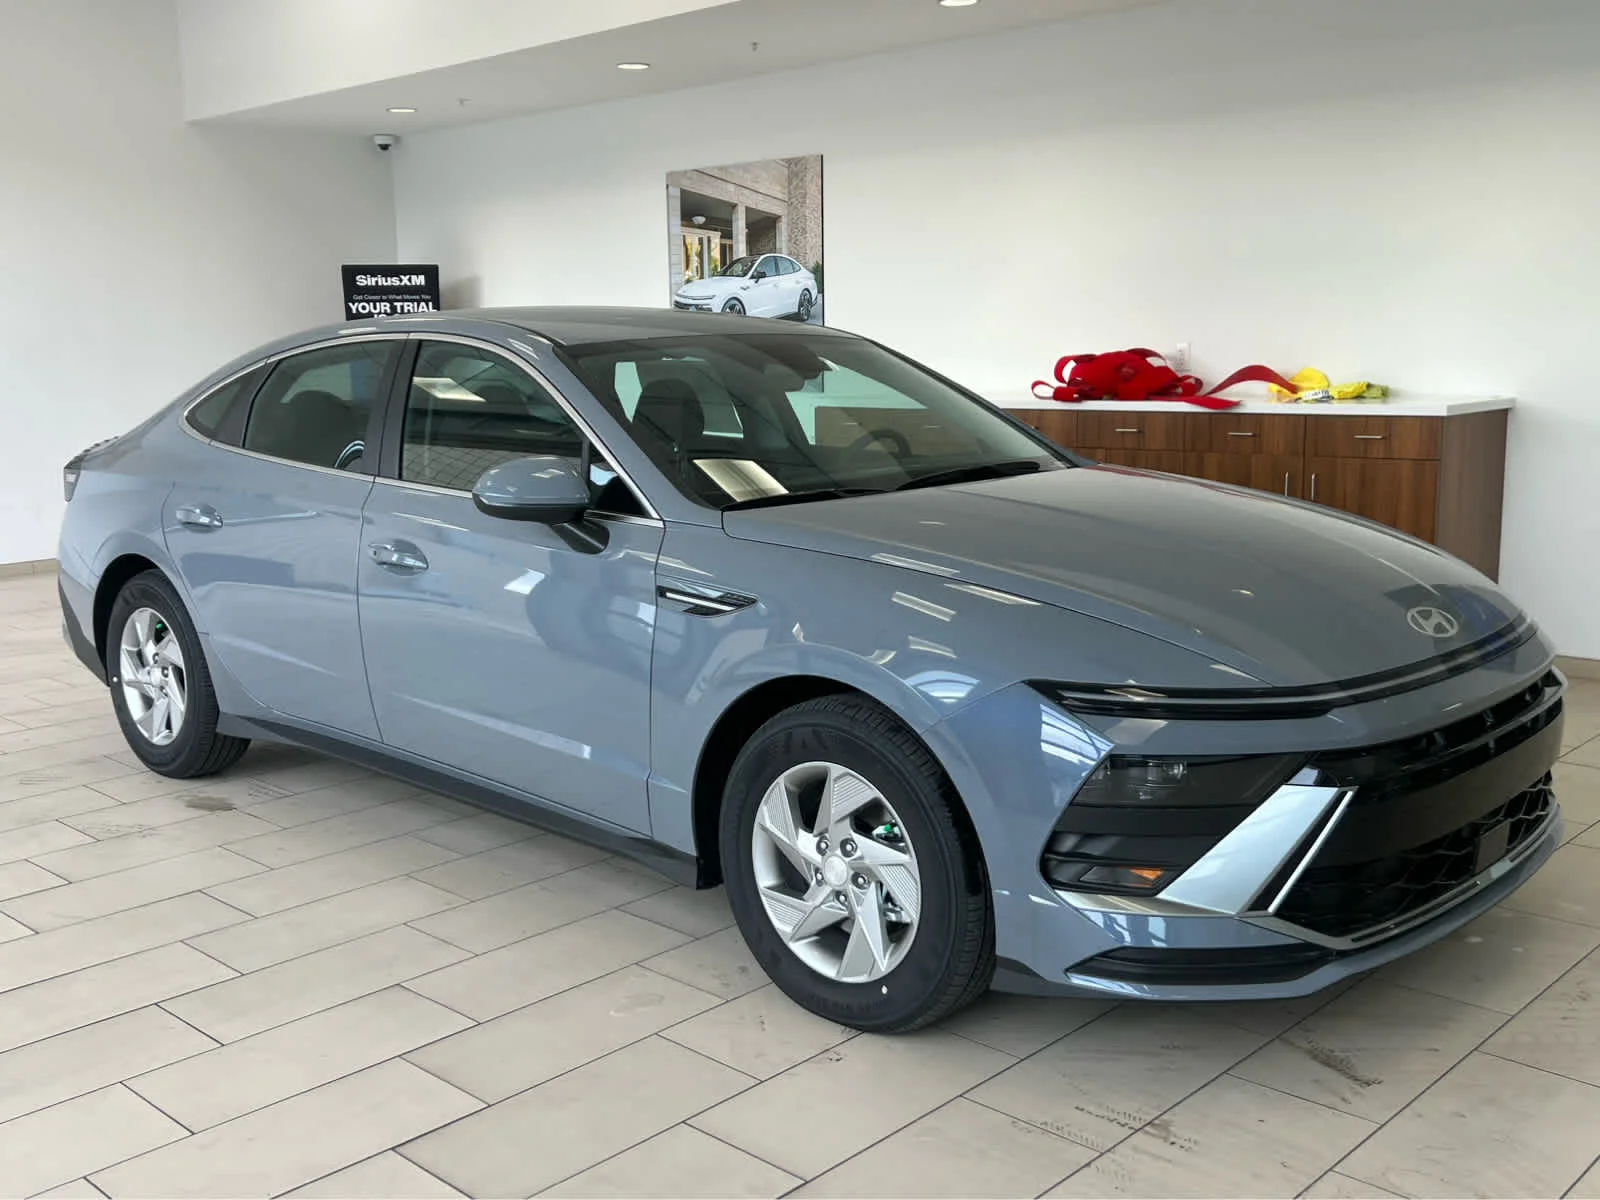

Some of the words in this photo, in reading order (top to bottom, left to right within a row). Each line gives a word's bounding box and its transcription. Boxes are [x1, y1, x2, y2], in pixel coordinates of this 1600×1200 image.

[355, 274, 425, 286] SiriusXM
[348, 302, 391, 313] YOUR
[393, 301, 438, 313] TRIAL
